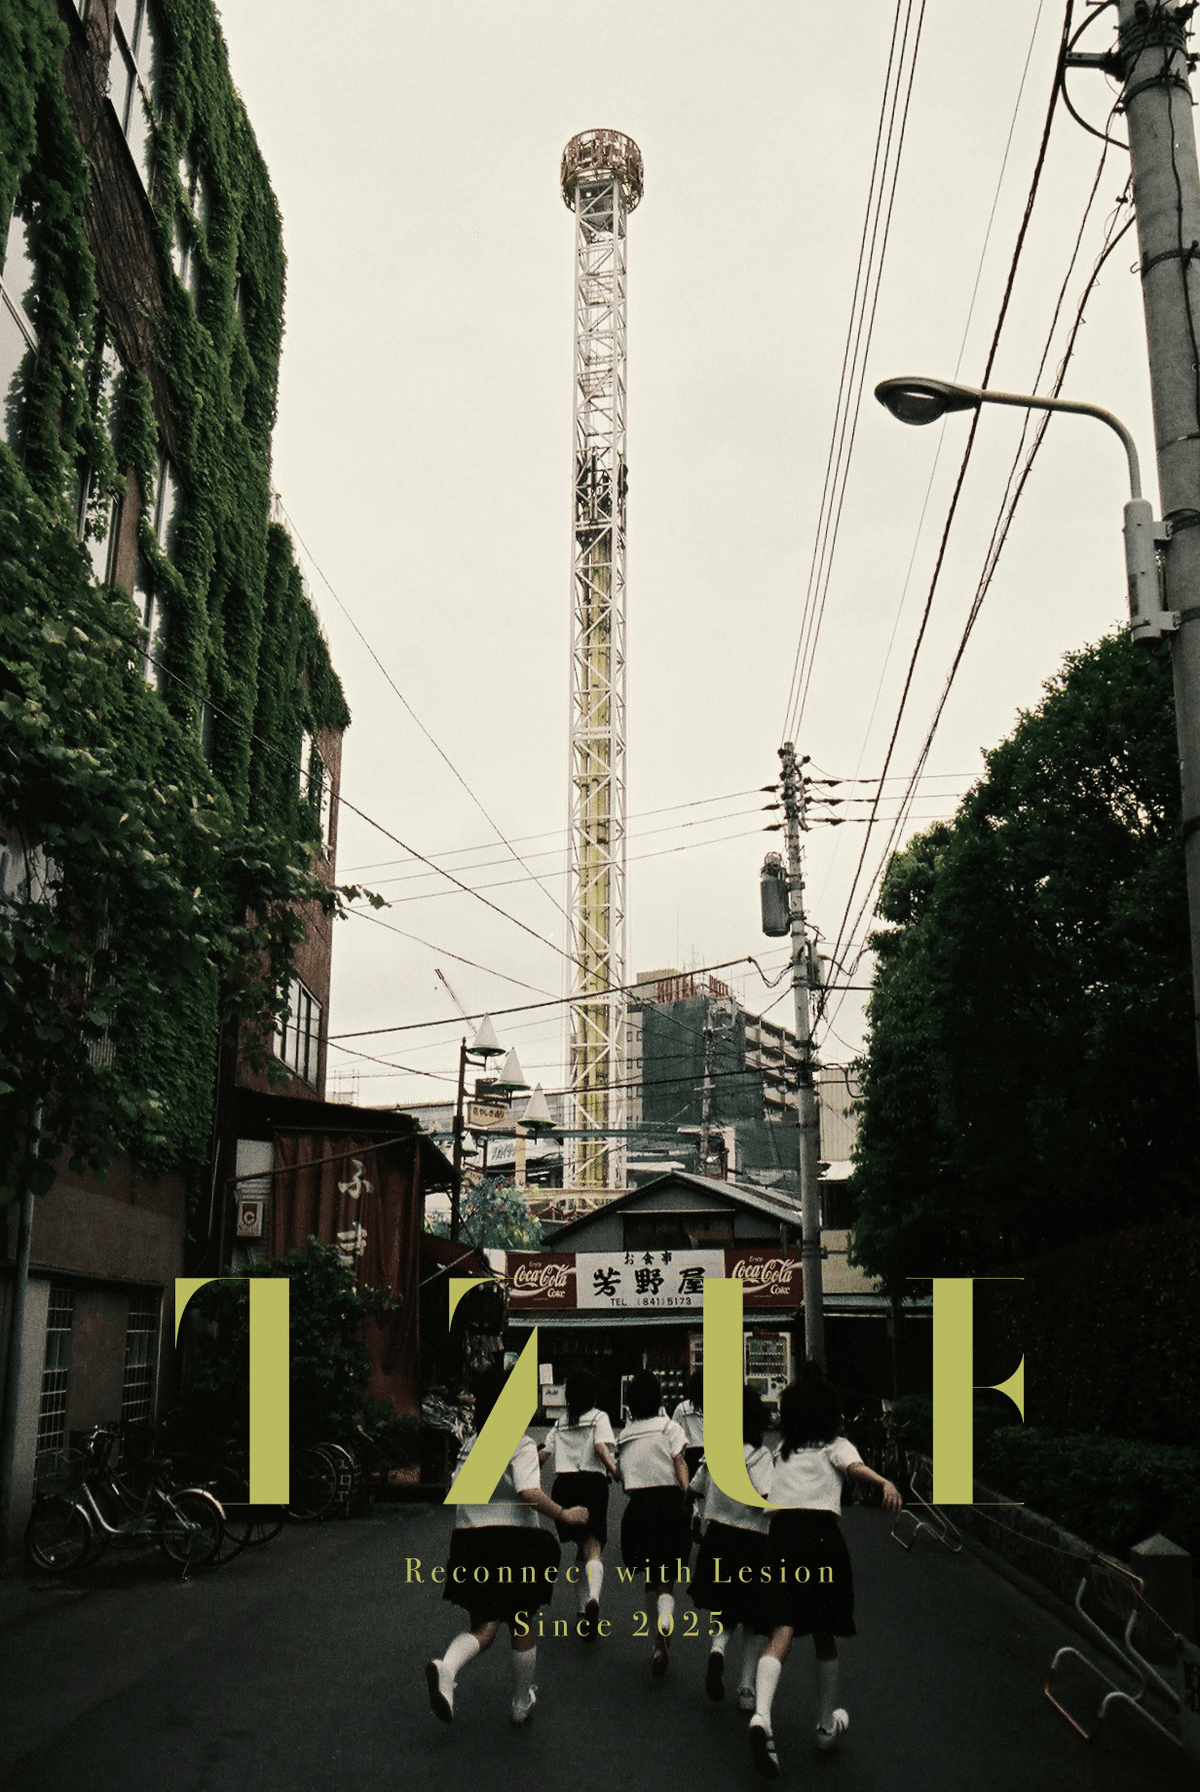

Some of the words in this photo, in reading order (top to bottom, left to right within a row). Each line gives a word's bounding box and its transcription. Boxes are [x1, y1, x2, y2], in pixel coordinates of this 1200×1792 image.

[624, 1249, 673, 1266] お食事
[513, 1264, 570, 1288] Coca-Cola
[592, 1266, 706, 1297] 芳野屋
[547, 1287, 566, 1299] Coke
[770, 1284, 791, 1295] Coke
[610, 1297, 628, 1307] TEL
[637, 1297, 692, 1307] (841)5173
